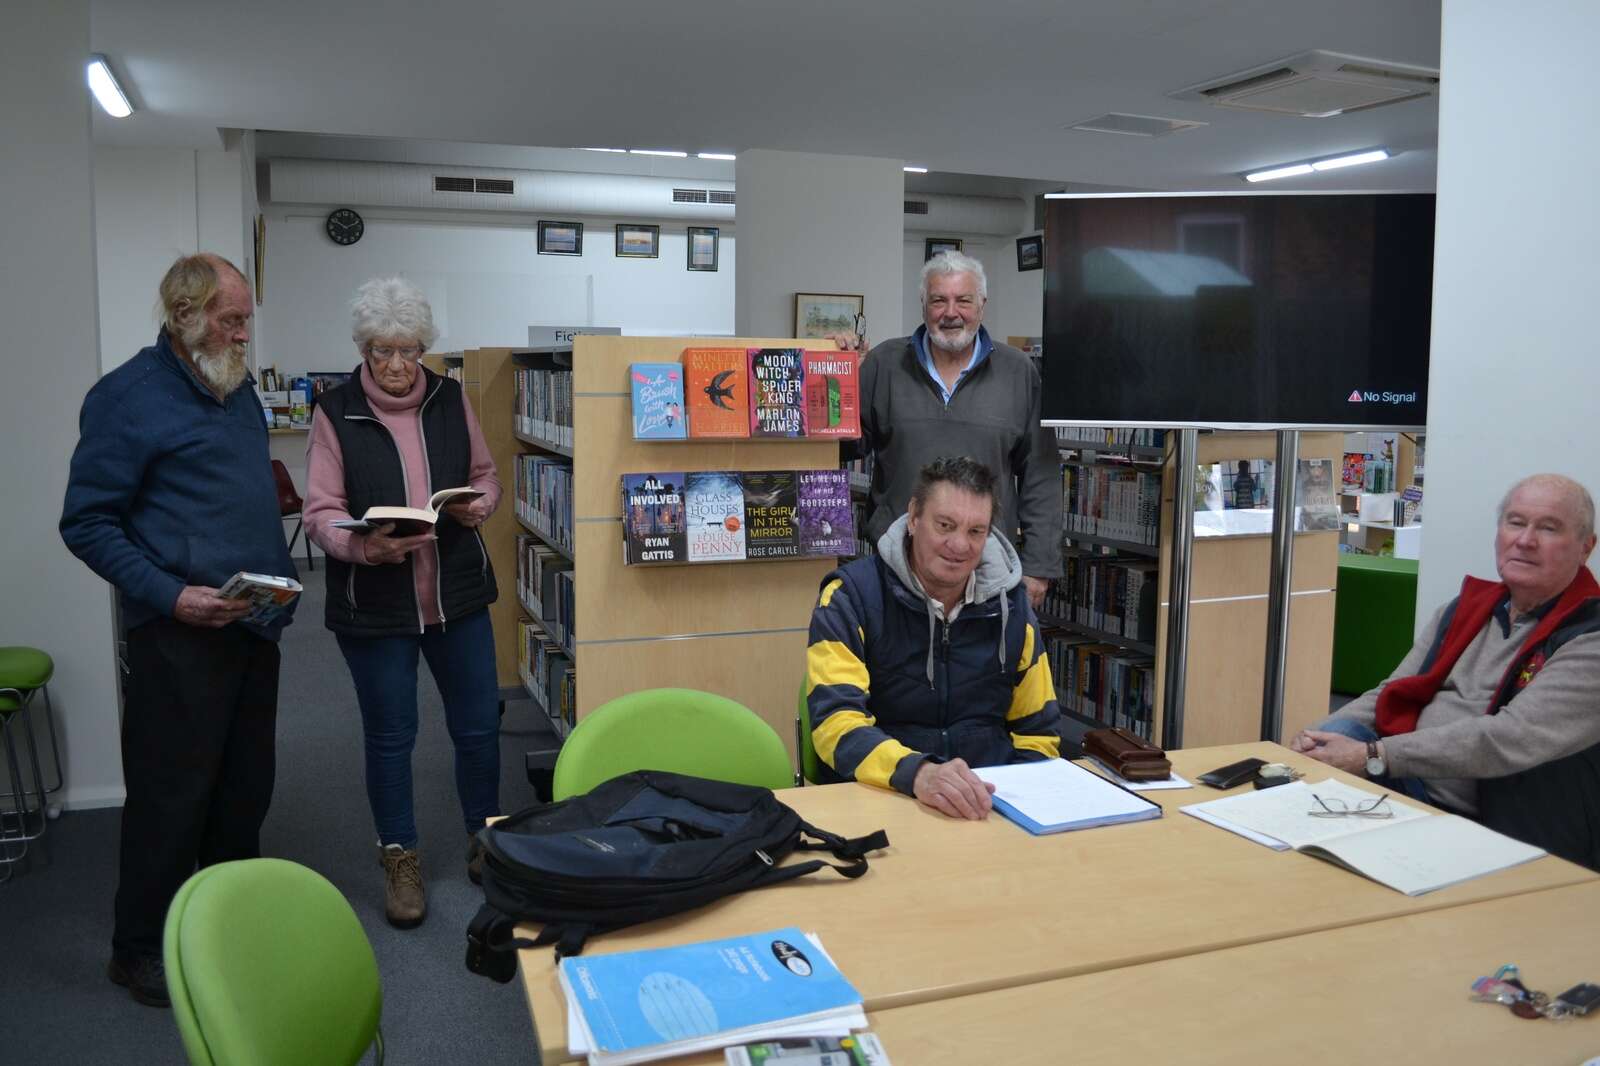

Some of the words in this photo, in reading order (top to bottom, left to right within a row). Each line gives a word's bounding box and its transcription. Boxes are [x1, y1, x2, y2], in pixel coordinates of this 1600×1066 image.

[763, 355, 794, 367] MOON
[756, 367, 789, 379] WITCH
[808, 361, 852, 375] PHARMACIST
[762, 380, 801, 392] SPIDER
[640, 382, 677, 404] Brush
[768, 392, 793, 404] KING
[1363, 391, 1380, 402] No
[1382, 391, 1416, 404] Signal
[757, 408, 800, 420] MARLON
[763, 420, 800, 432] JAMES
[800, 475, 814, 483] LET
[832, 474, 847, 482] DIE
[645, 480, 664, 490] ALL
[630, 494, 680, 505] INVOLVED
[696, 493, 733, 504] GLASS
[801, 498, 847, 507] FOOTSTEPS
[690, 503, 739, 516] HOUSES
[746, 507, 767, 516] THE
[769, 506, 794, 516] GIRL
[753, 517, 765, 527] IN
[768, 517, 788, 526] THE
[697, 532, 736, 543] LOUISE
[750, 527, 793, 538] MIRROR
[645, 538, 669, 547] RYAN
[692, 541, 742, 555] PENNY
[641, 550, 674, 560] GATTIS
[748, 546, 766, 556] ROSE
[768, 545, 798, 556] CARLYLE
